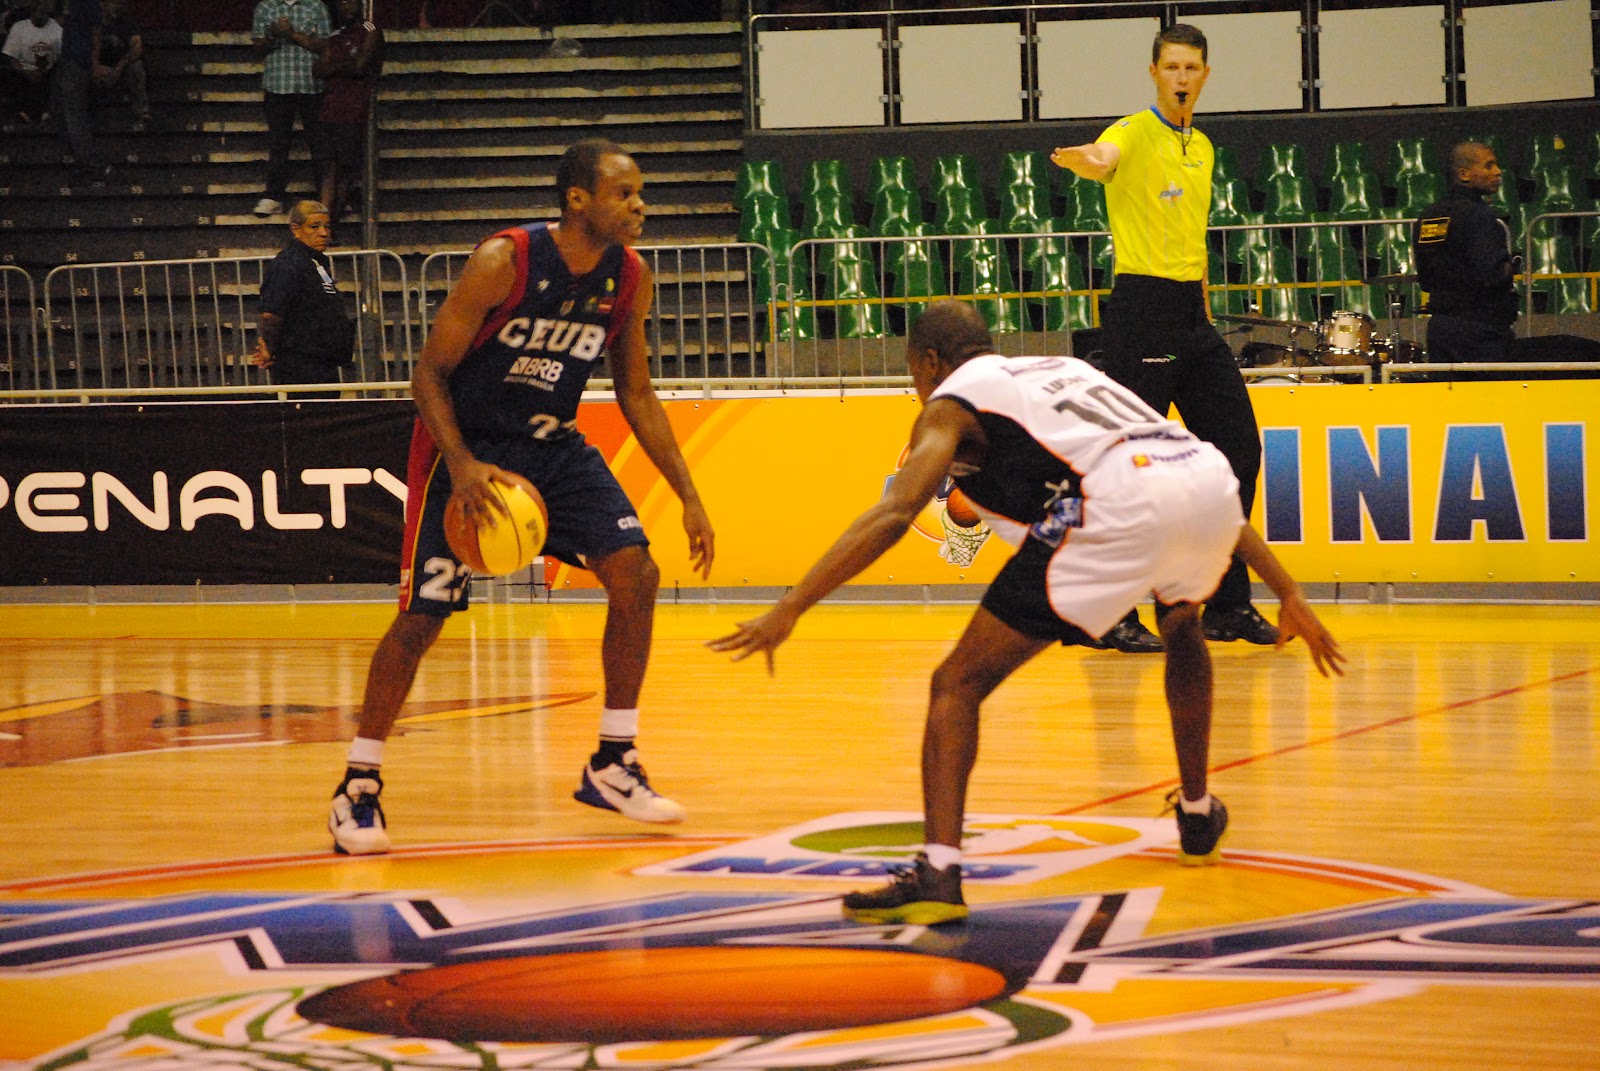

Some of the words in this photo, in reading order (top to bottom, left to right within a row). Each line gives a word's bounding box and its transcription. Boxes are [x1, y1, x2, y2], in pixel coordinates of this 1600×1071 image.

[497, 317, 606, 362] CEUB
[523, 357, 564, 383] BRB
[1052, 385, 1160, 430] 10
[0, 468, 409, 532] ENALT
